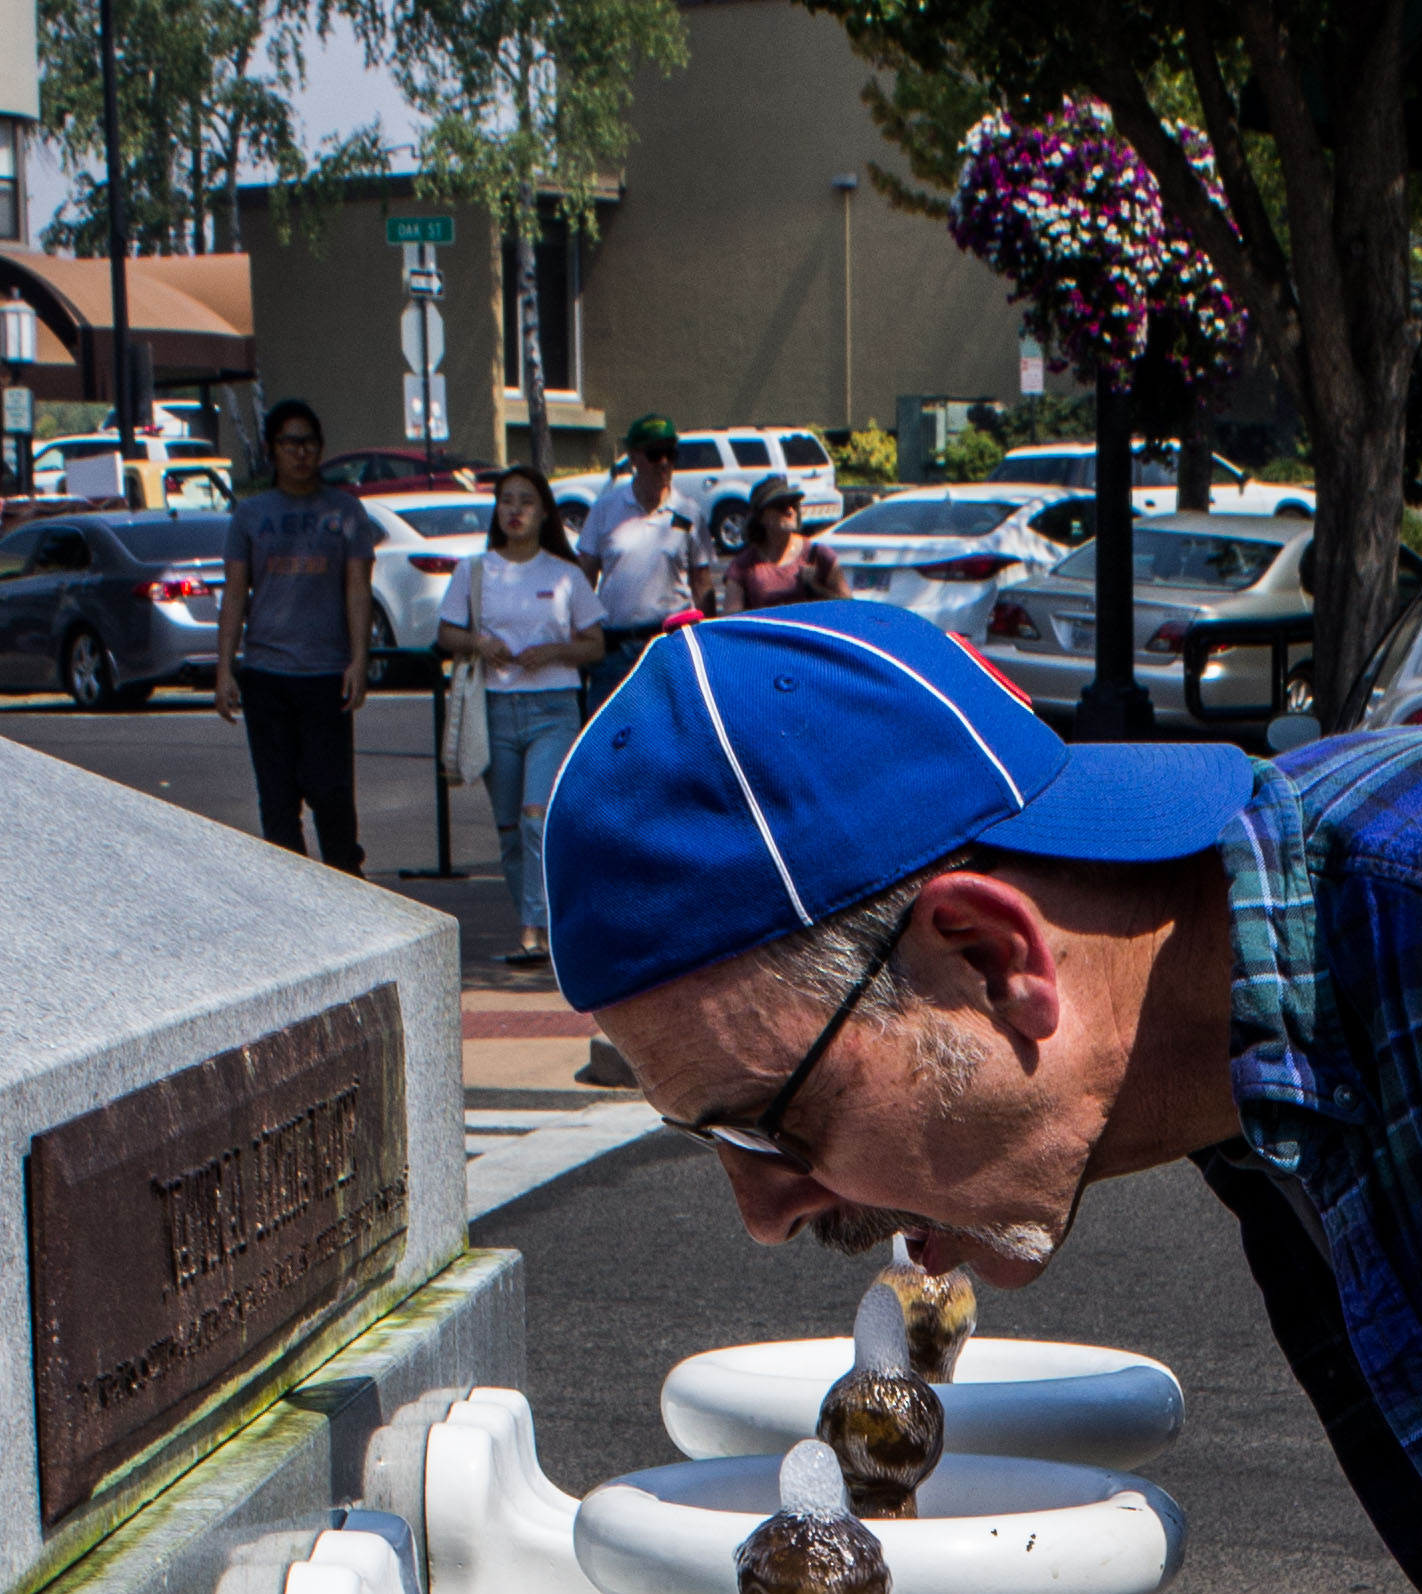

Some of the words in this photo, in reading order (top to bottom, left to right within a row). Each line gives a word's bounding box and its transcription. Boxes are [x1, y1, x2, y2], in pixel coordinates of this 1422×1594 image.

[397, 222, 420, 235] OAK
[427, 222, 442, 235] ST
[258, 512, 343, 536] AERO
